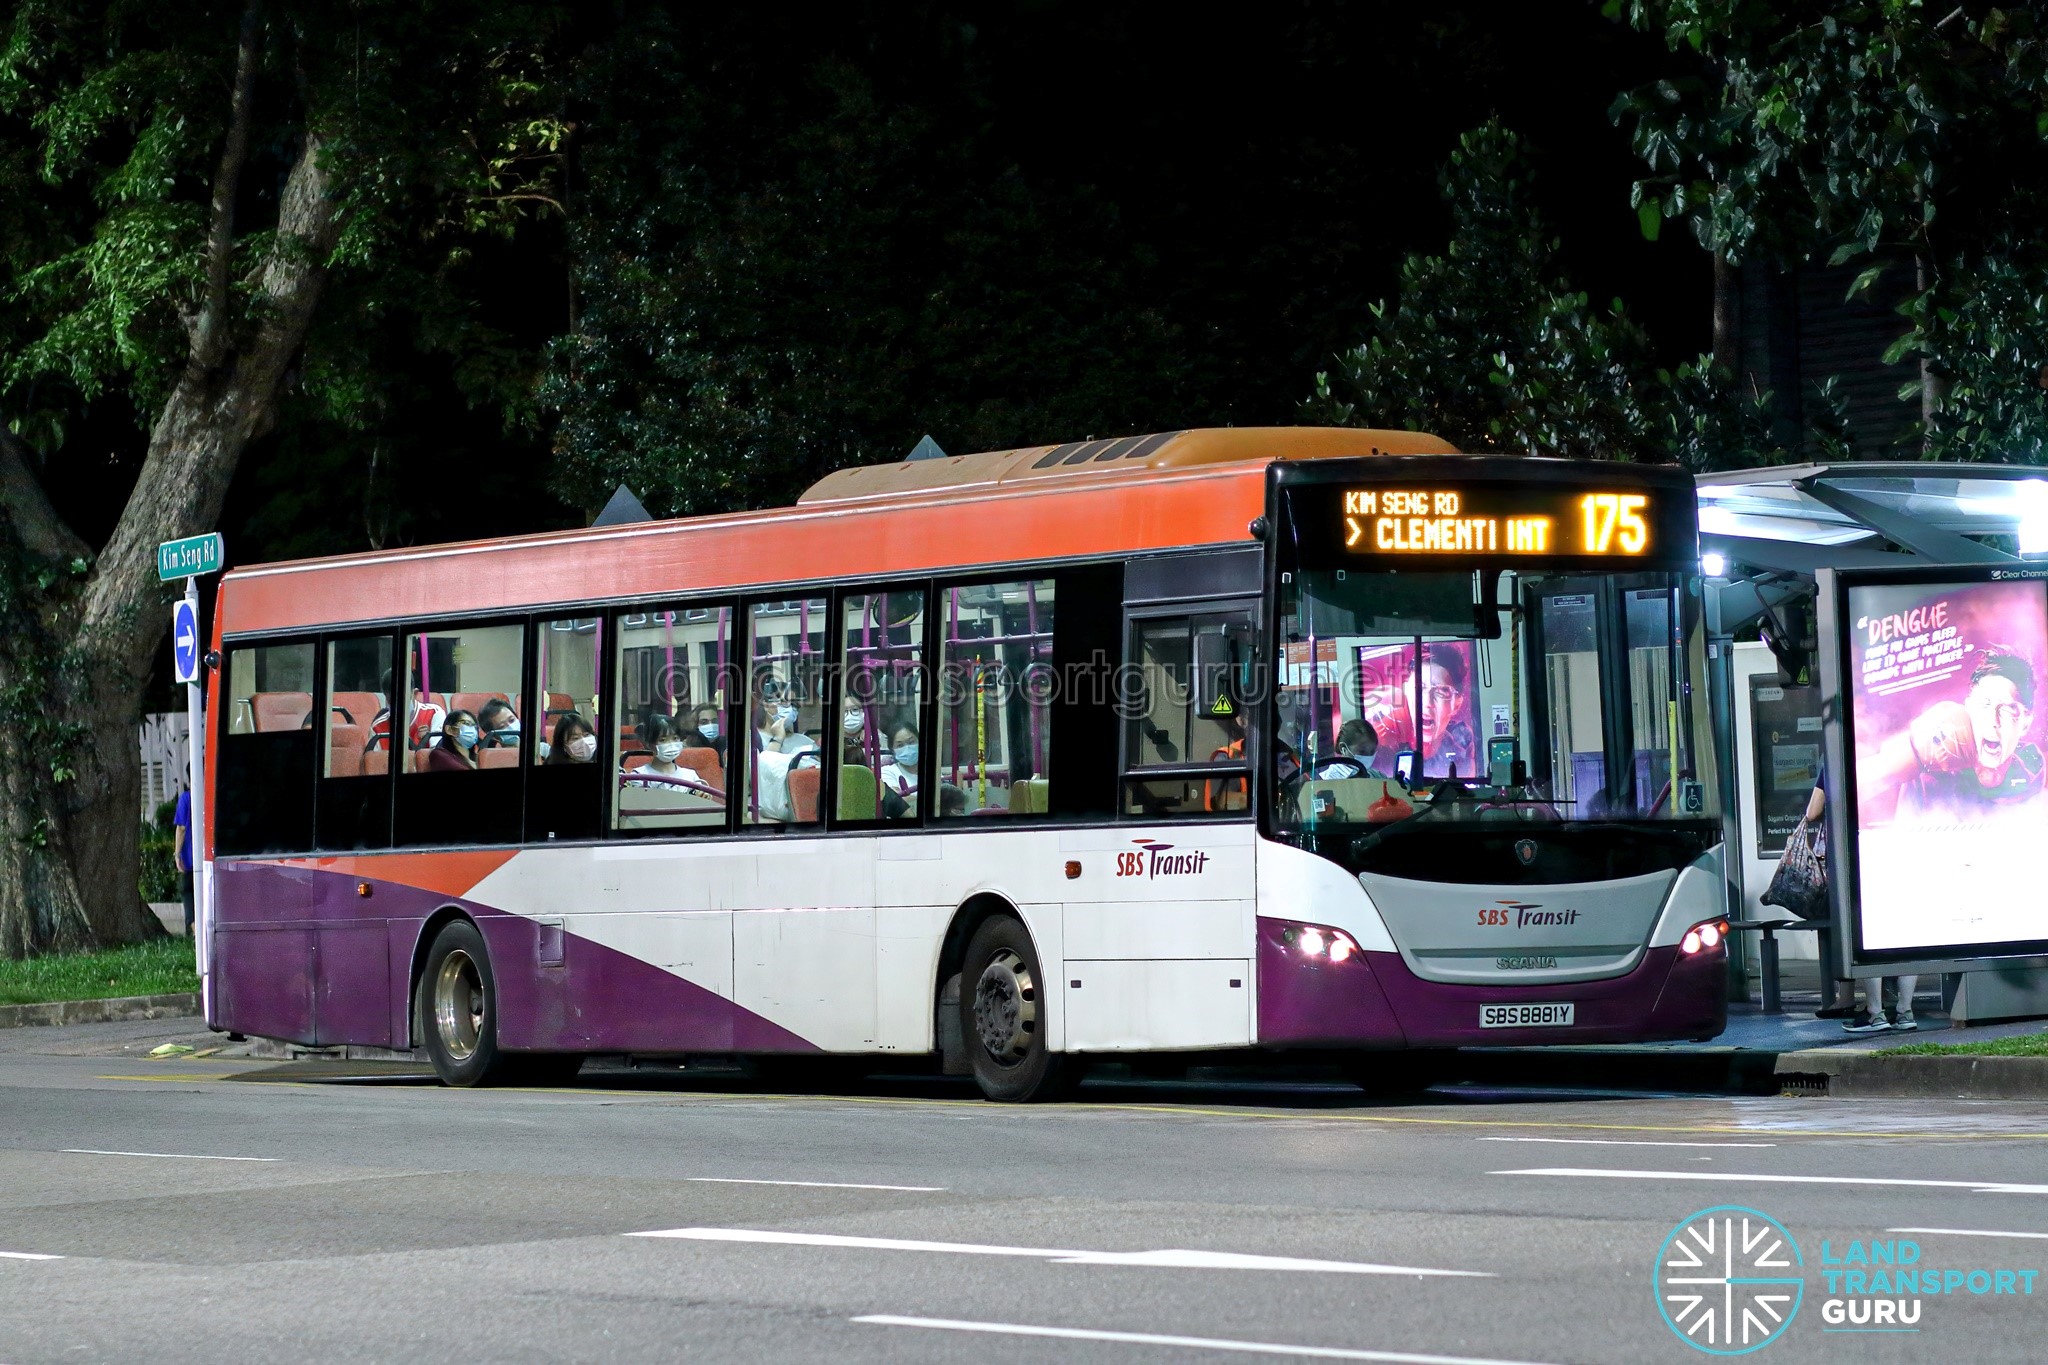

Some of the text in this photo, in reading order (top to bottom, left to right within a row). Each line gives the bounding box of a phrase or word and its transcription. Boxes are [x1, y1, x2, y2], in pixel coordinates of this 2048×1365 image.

[1346, 492, 1458, 515] KIM SENG RD
[1377, 518, 1497, 550] CLEMENTI
[1507, 517, 1550, 551] INT
[1580, 494, 1647, 553] 175
[163, 539, 214, 570] Kim Seng Rd
[1116, 844, 1210, 880] SBS Transit
[1478, 904, 1581, 929] SBS Transit
[1496, 956, 1558, 969] SCANIA
[1485, 1006, 1570, 1025] SBS8881Y
